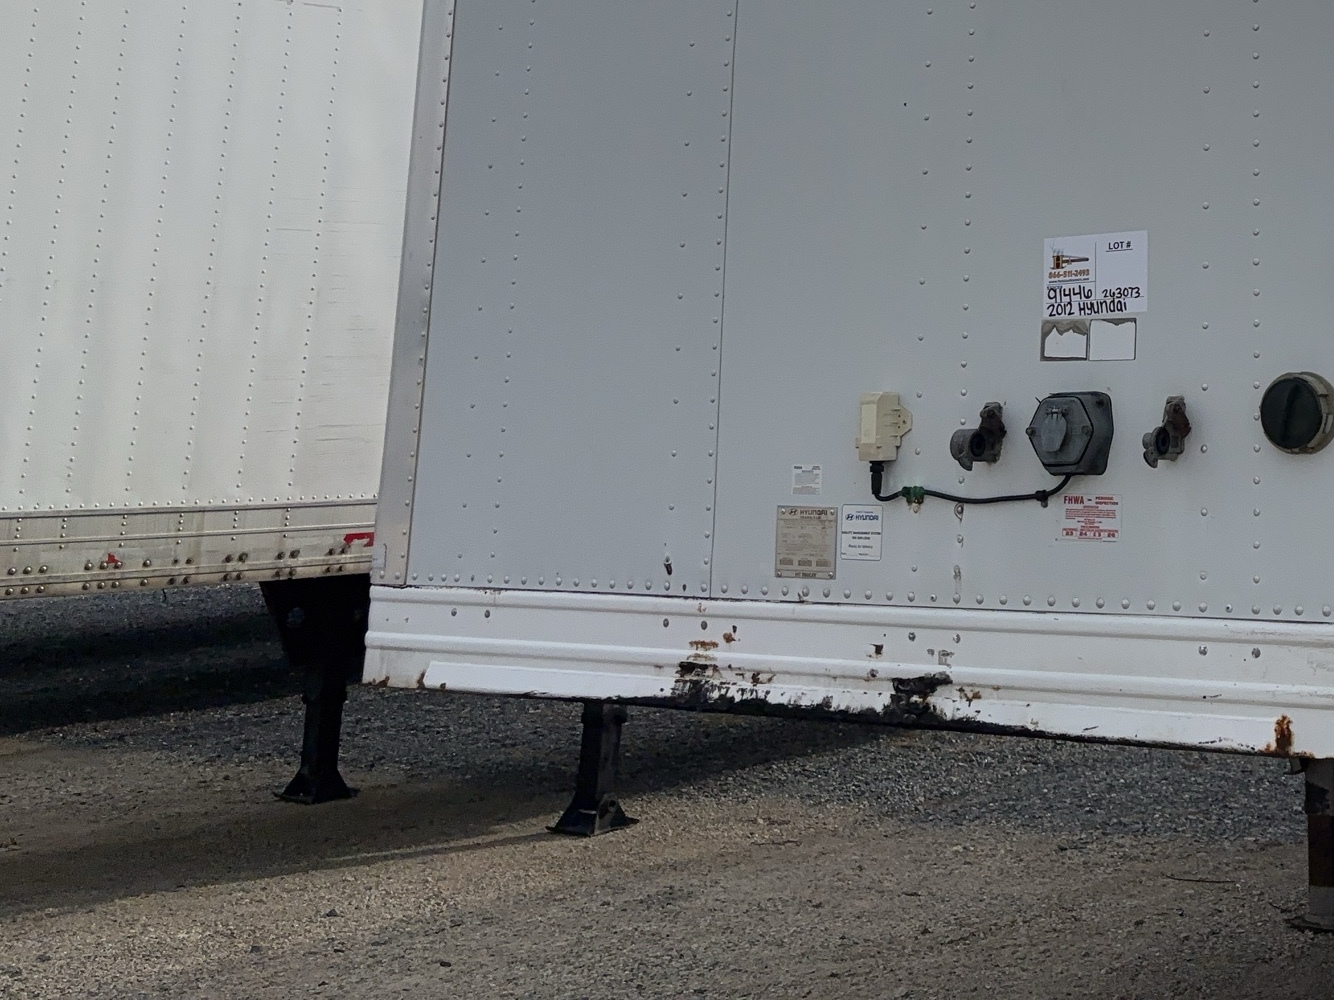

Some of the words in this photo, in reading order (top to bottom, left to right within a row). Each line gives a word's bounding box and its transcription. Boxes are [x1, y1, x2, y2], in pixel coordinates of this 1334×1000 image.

[1108, 242, 1124, 250] LOT
[1047, 285, 1093, 304] 91446
[1047, 302, 1075, 317] 2012
[1078, 299, 1127, 316] Hyundai
[1064, 496, 1084, 504] FHWA
